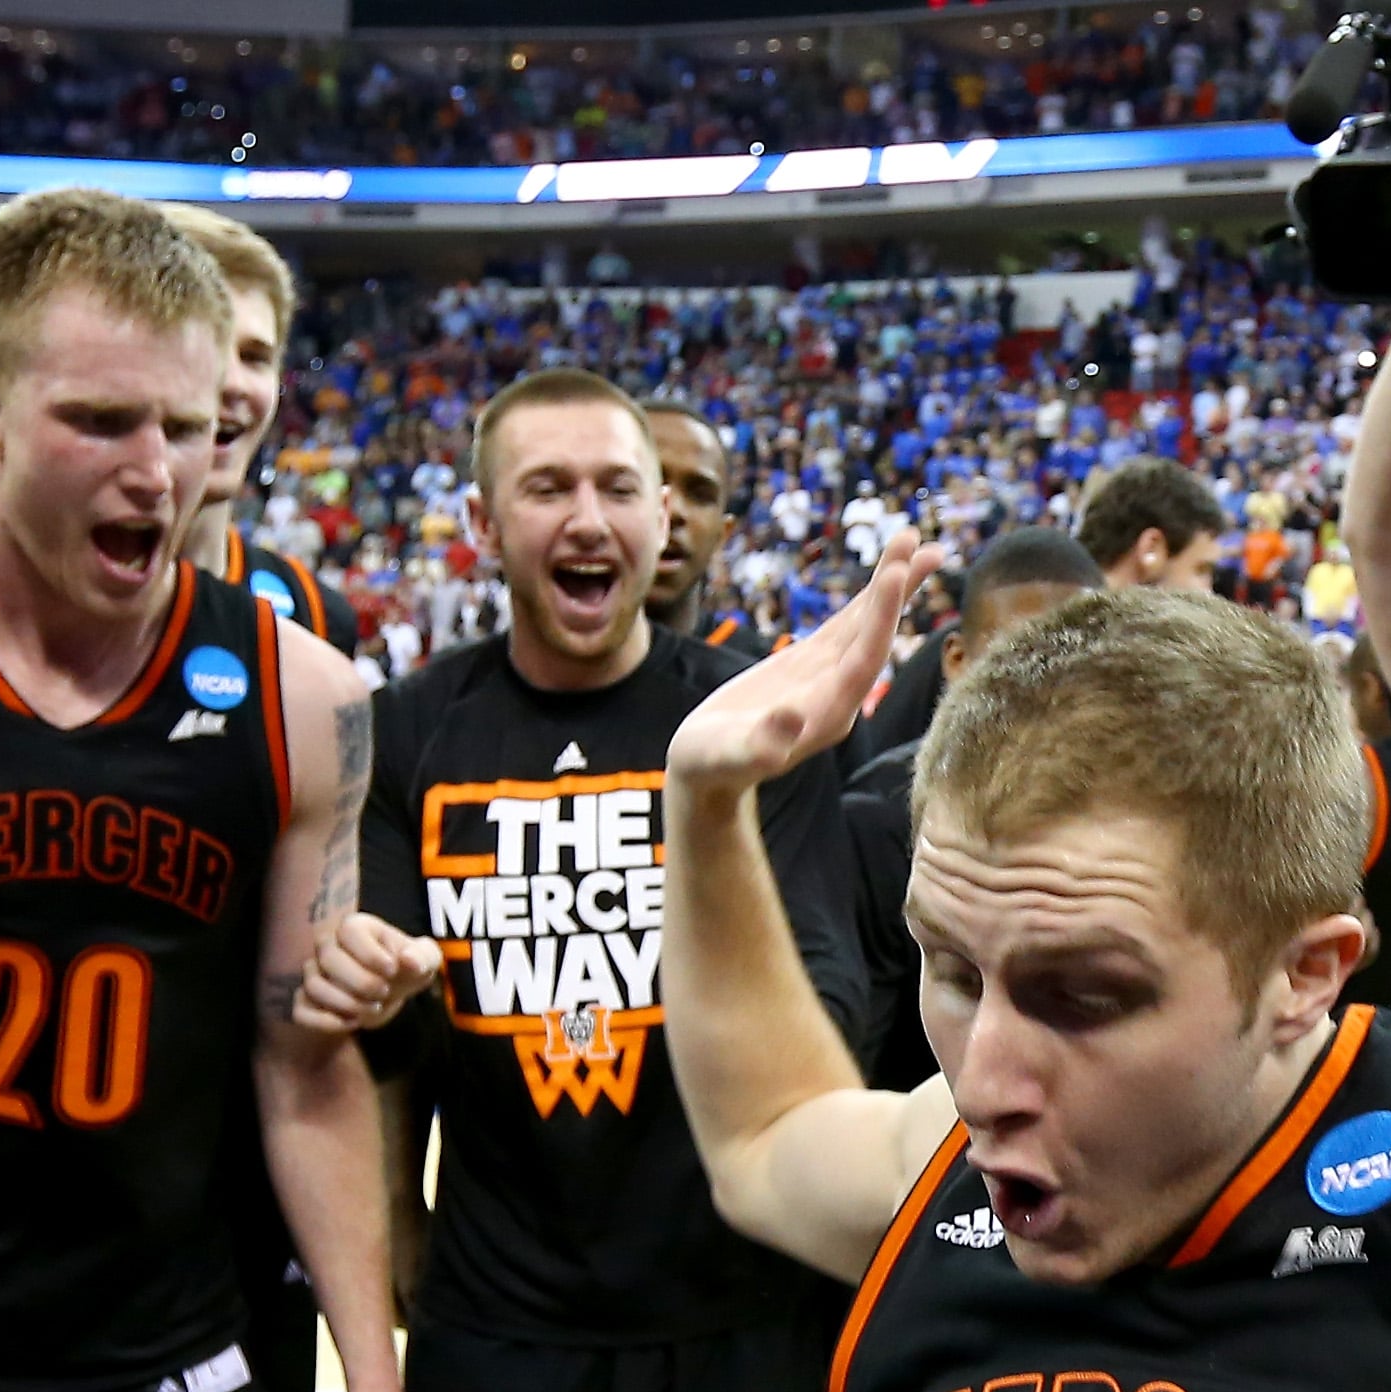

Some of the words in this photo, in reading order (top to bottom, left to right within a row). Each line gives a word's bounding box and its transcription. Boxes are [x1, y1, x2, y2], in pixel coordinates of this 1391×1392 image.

[486, 789, 653, 876] THE
[427, 867, 665, 939] MERCE
[470, 931, 663, 1016] WAY
[935, 1222, 1005, 1249] adida
